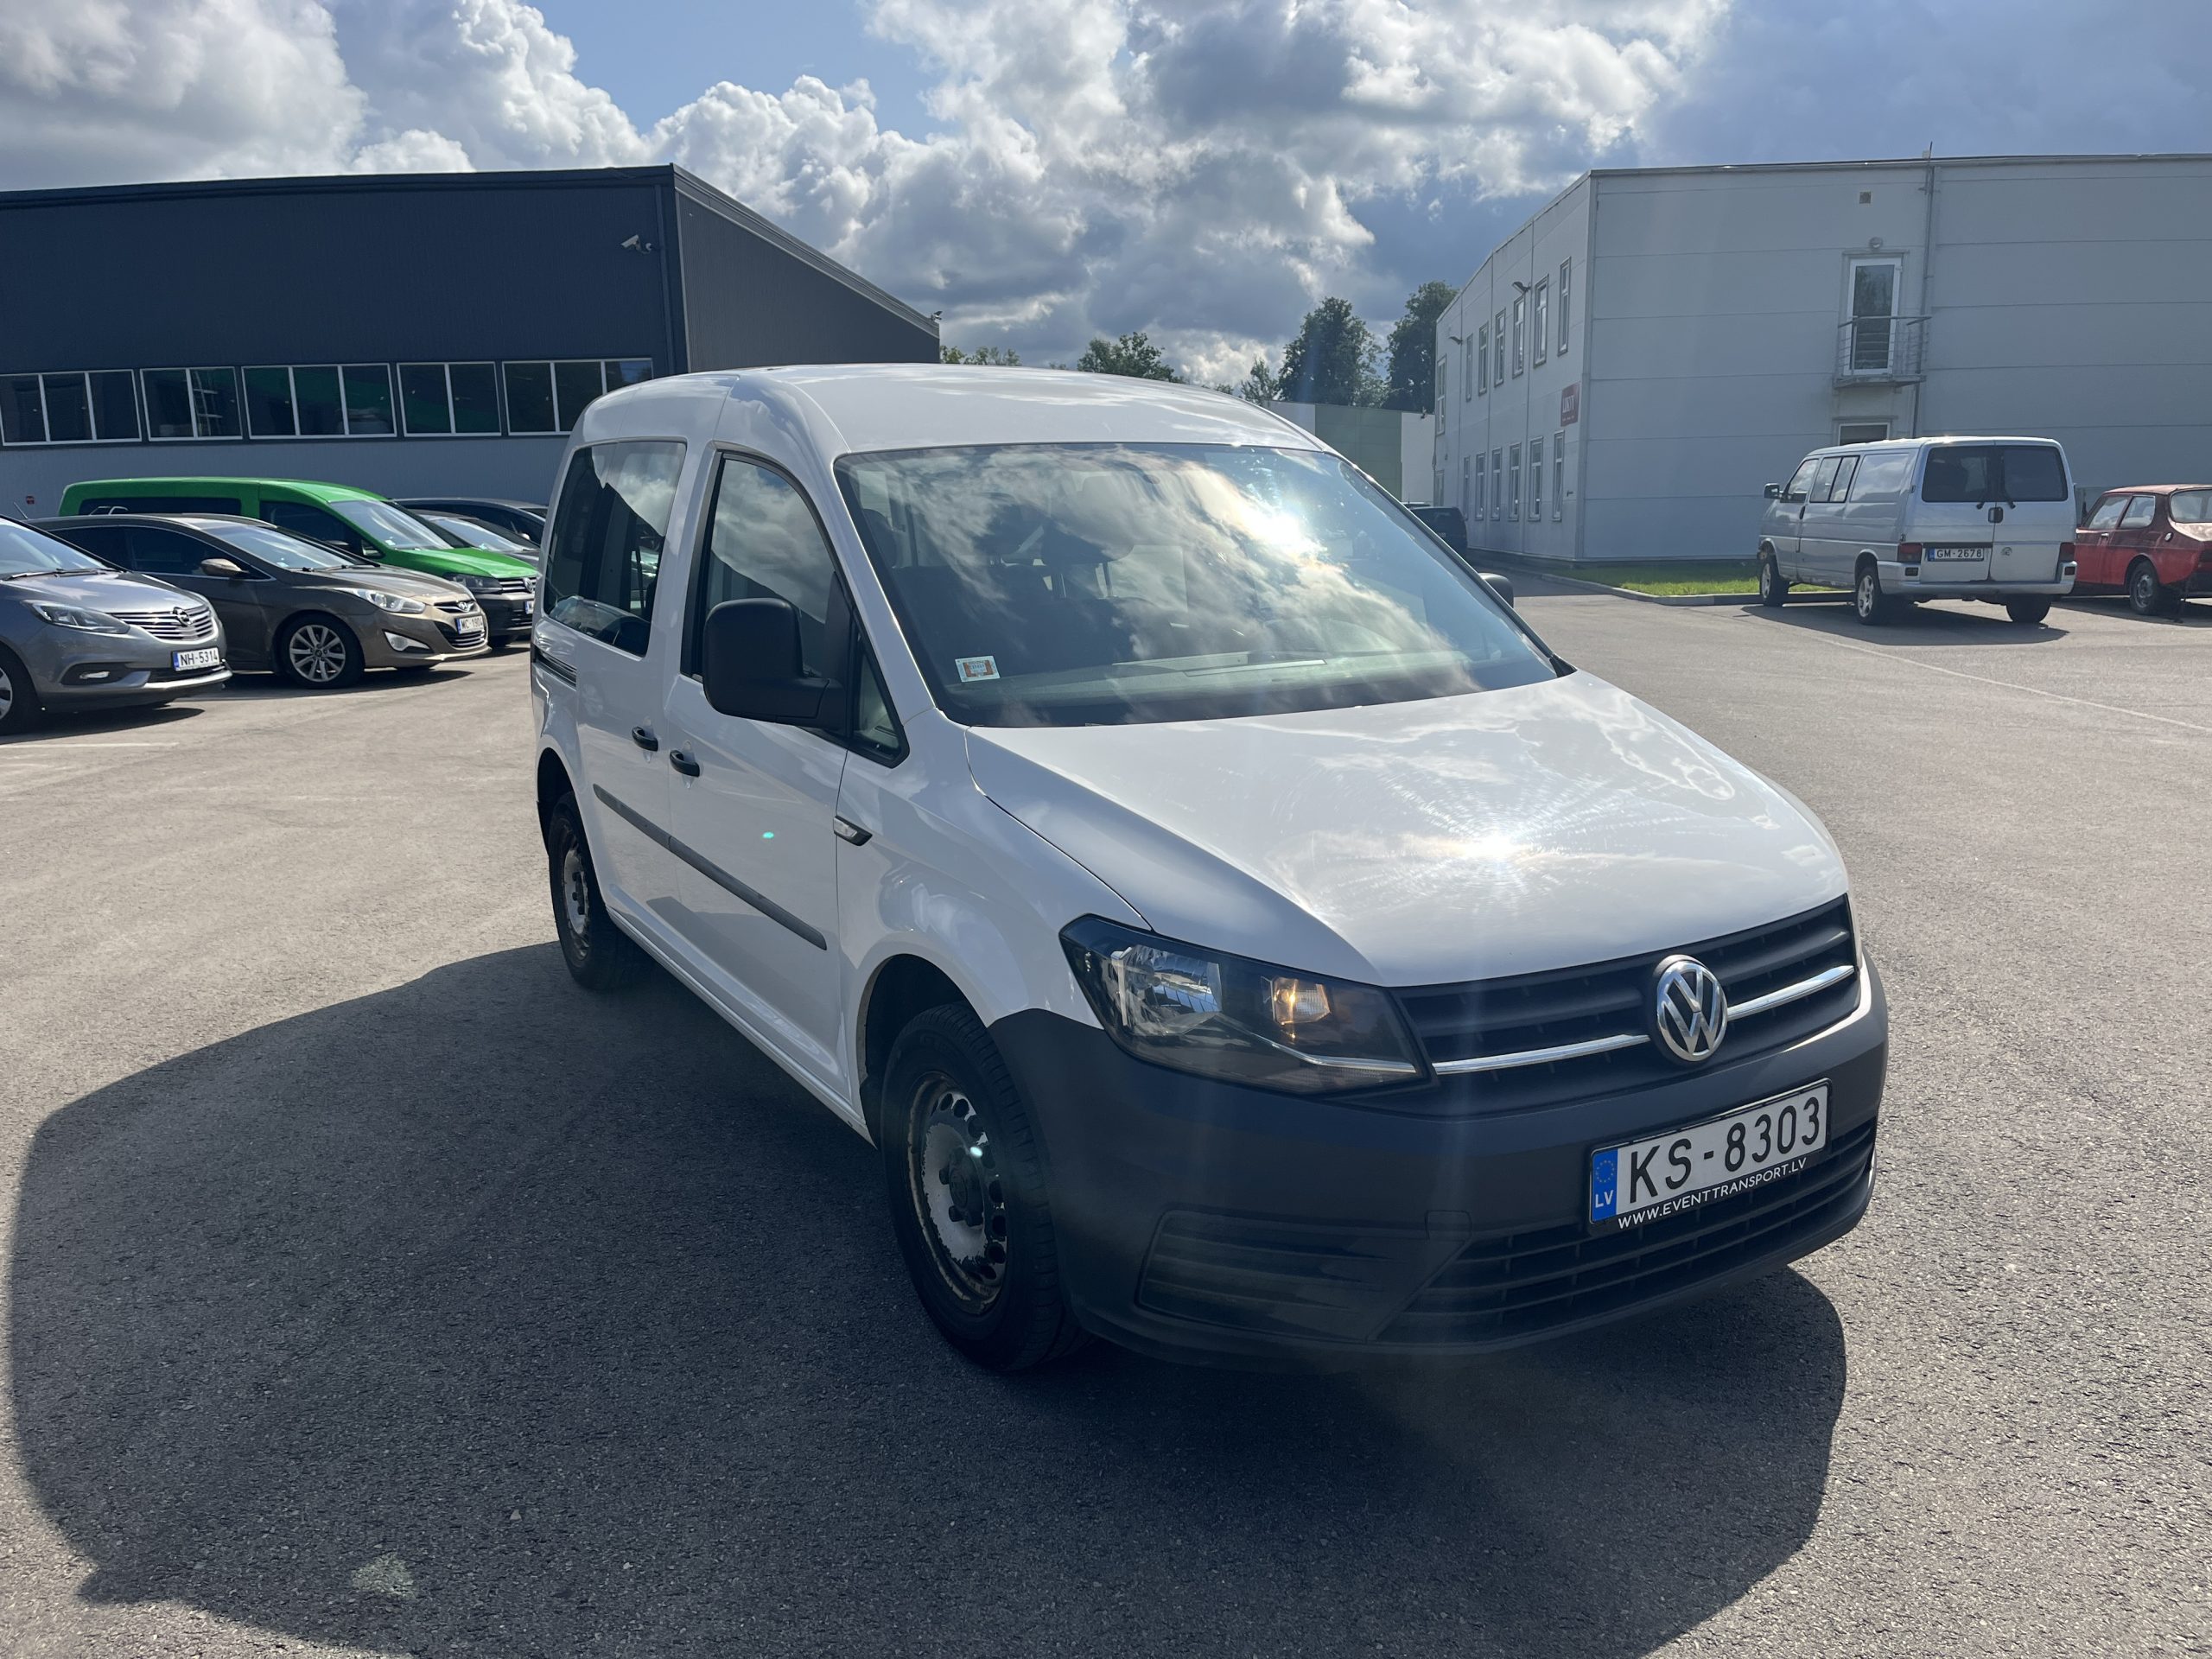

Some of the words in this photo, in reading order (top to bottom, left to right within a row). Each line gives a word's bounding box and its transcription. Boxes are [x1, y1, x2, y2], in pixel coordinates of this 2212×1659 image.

[1936, 549, 1982, 558] GM-2678
[180, 650, 218, 666] NH-5314
[1630, 1096, 1821, 1204] KS-8303
[1595, 1190, 1614, 1209] LV
[1618, 1157, 1808, 1230] WWW.EVENTTRANSPORT.LV
